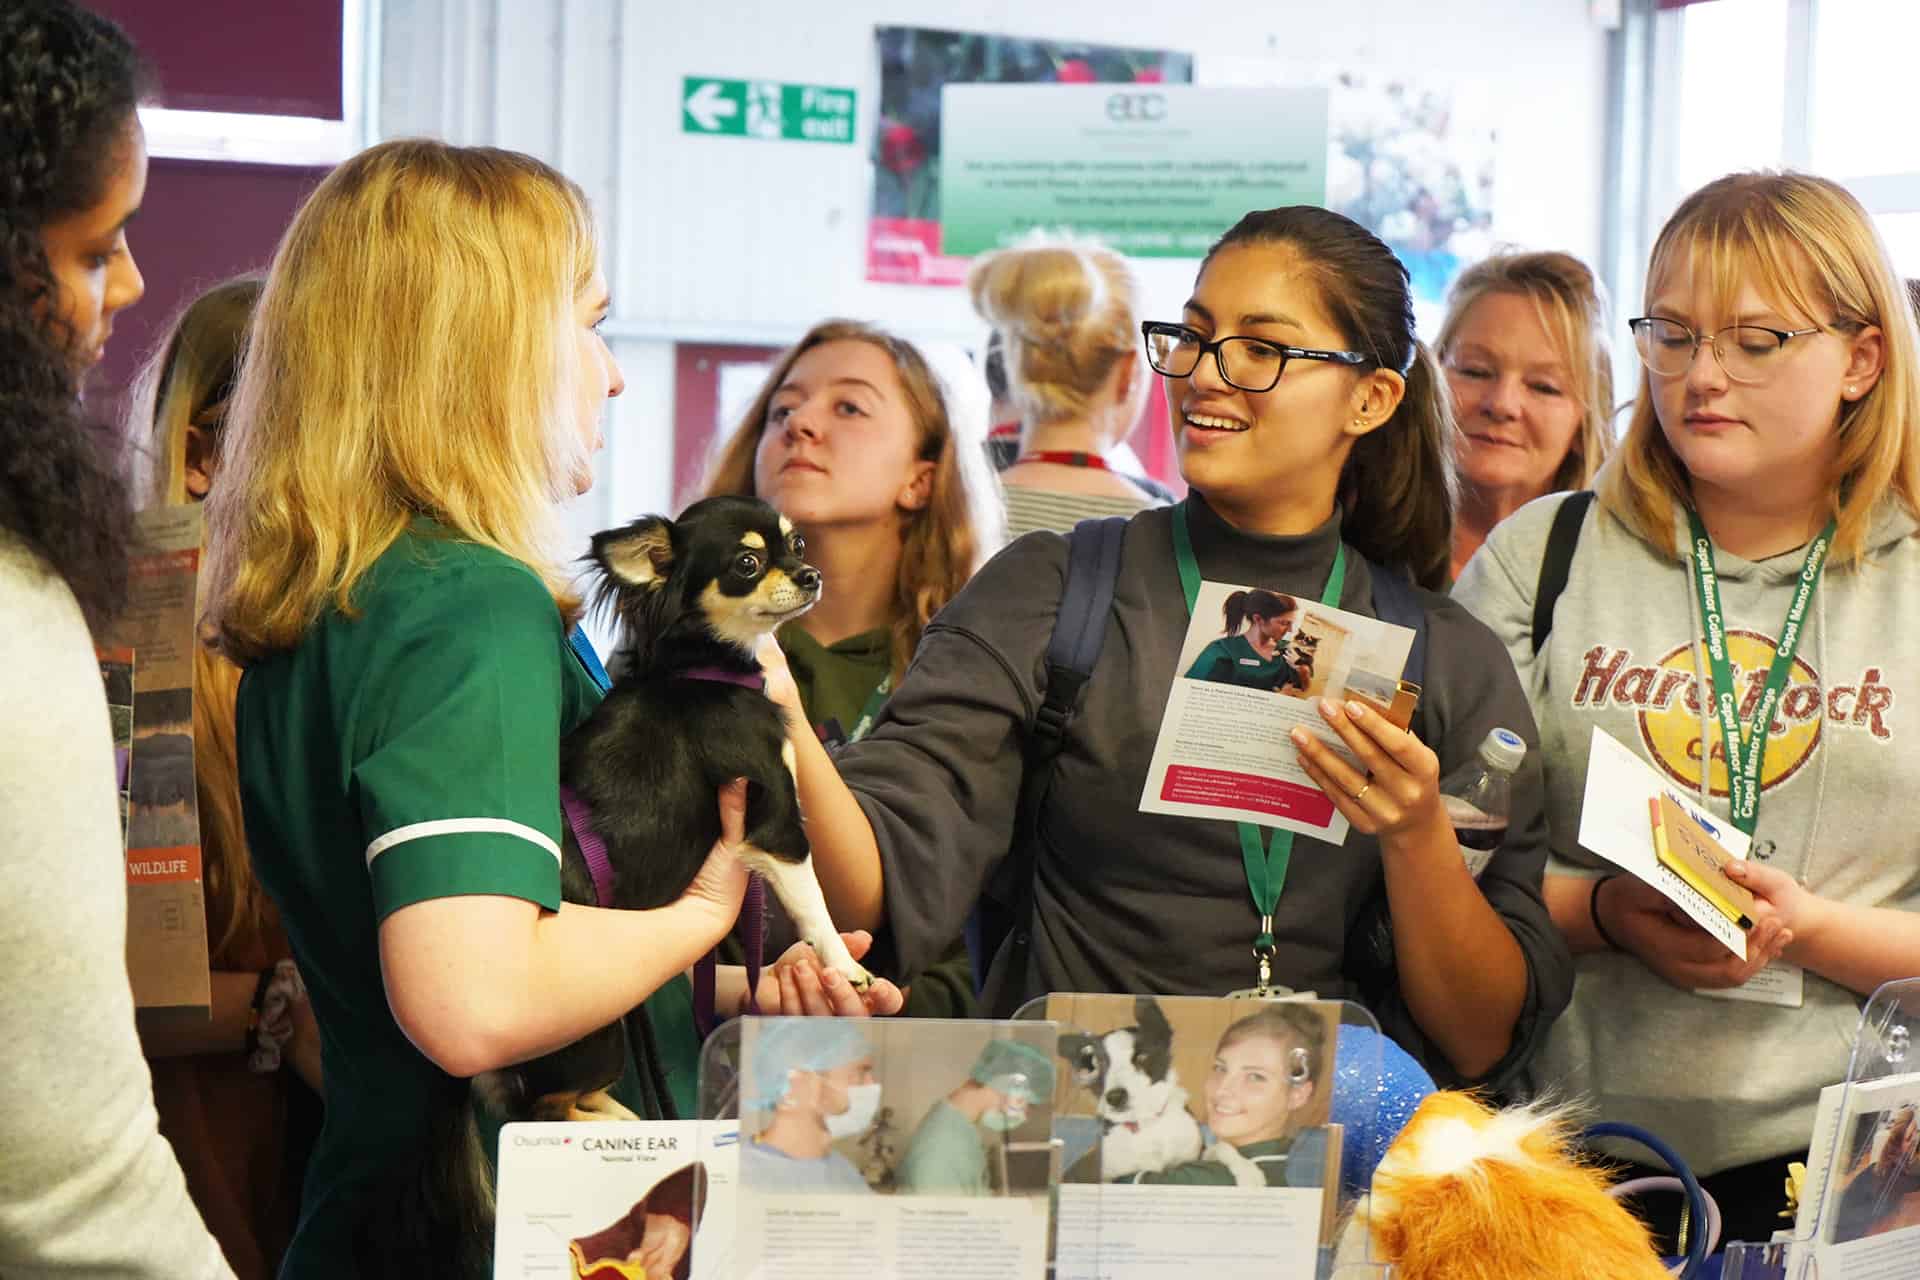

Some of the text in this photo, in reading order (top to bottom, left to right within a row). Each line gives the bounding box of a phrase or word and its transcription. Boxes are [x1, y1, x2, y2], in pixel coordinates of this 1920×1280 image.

[802, 87, 850, 112] Fire
[802, 118, 849, 139] exit
[1697, 538, 1724, 661] Capel Manor College
[1777, 538, 1827, 657] Capel Manor College
[1721, 693, 1738, 731] Capel
[1727, 731, 1742, 774] Manor
[1741, 688, 1776, 819] Capel Manor College
[128, 860, 189, 876] WILDLIFE
[582, 1137, 641, 1151] CANINE
[647, 1137, 678, 1151] EAR
